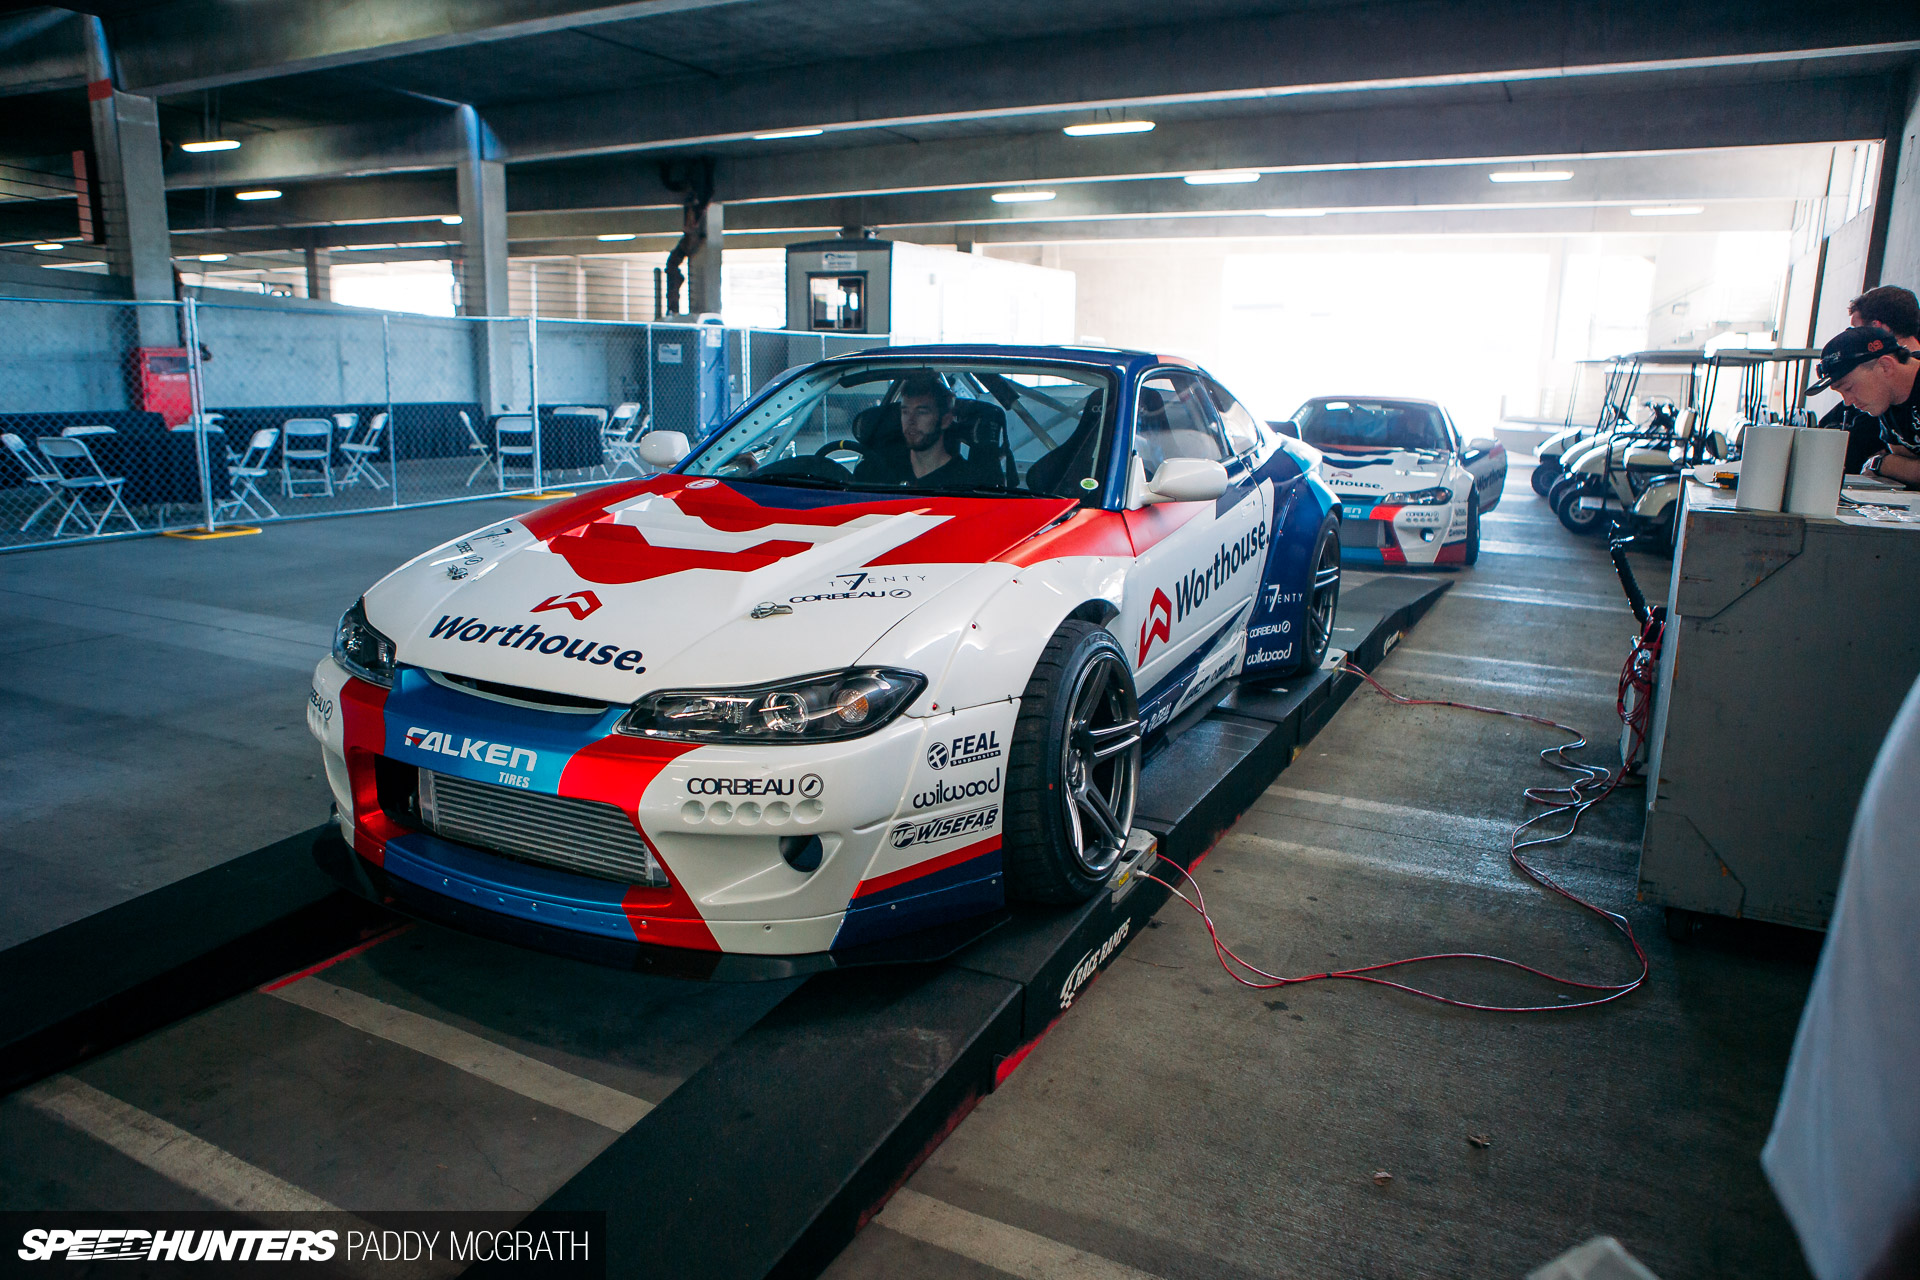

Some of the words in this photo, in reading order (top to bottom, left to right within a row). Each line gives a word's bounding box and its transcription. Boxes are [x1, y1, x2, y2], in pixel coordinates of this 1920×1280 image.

[1325, 479, 1384, 490] thouse.
[828, 575, 927, 588] TWENTY
[1175, 519, 1271, 624] Worthouse.
[788, 590, 886, 604] CORBEAU
[1264, 593, 1304, 605] TWENTY
[1249, 623, 1282, 638] CORBEAU
[429, 614, 647, 675] Worthouse.
[1246, 642, 1293, 665] wilwood
[403, 726, 538, 772] FALKEN
[951, 730, 1000, 758] FEAL
[498, 771, 531, 788] TIRES
[687, 777, 795, 796] CORBEAU
[912, 767, 1001, 809] wilwood
[916, 808, 999, 842] WISEFAB
[1073, 948, 1101, 992] RACE
[1098, 916, 1131, 965] RAMPS
